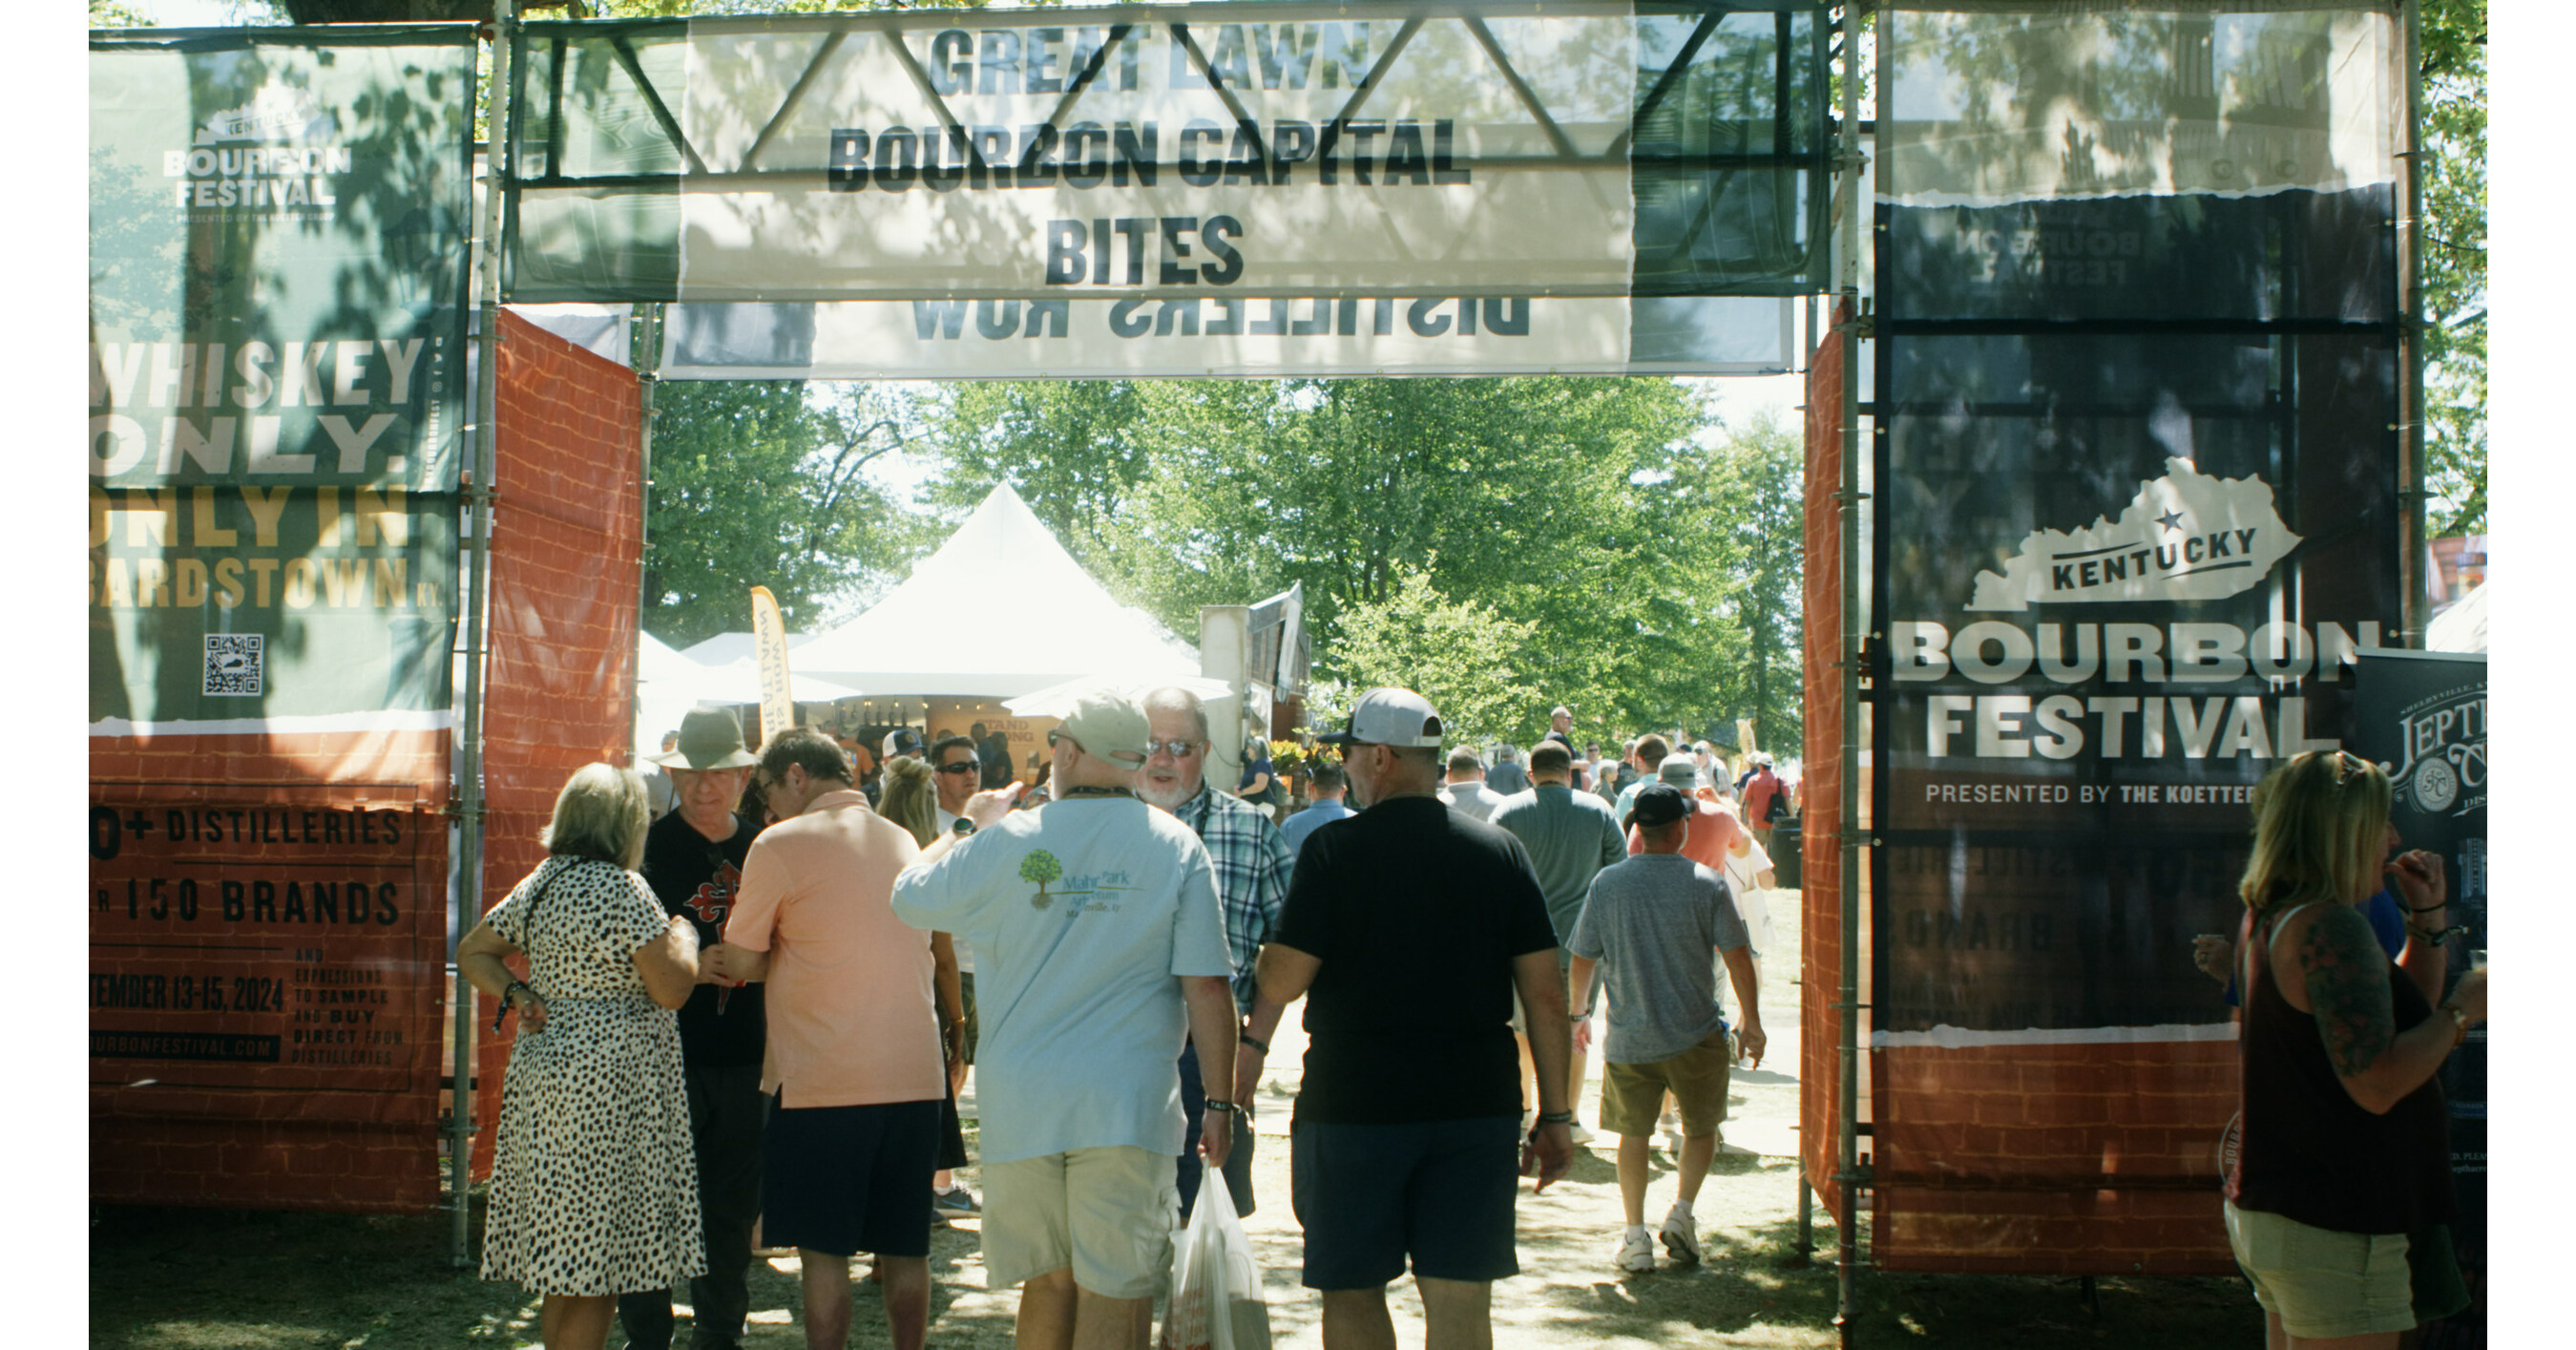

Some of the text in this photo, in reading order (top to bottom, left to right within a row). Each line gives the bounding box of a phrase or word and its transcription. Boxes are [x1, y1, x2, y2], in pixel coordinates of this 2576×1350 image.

[929, 21, 1370, 96] GREAT LAWN
[162, 146, 352, 178] BOURBON
[827, 117, 1472, 194] BOURBON CAPITAL
[176, 179, 337, 208] FESTIVAL
[1045, 215, 1245, 286] BITES
[89, 337, 426, 410] WHISKEY
[89, 412, 406, 477] ONLY.
[317, 484, 409, 548] IN
[2051, 527, 2257, 592] KENTUCKY
[89, 557, 444, 609] ARDSTOWN KY.
[1891, 620, 2380, 684] BOURBON
[1926, 694, 2342, 760] FESTIVAL
[1925, 785, 2070, 804] PRESENTED
[2080, 785, 2110, 804] BY
[2120, 785, 2160, 804] THE
[167, 810, 400, 845] DISTILLERIES
[128, 878, 198, 922] 150
[221, 879, 399, 926] BRANDS
[295, 948, 324, 963] AND
[295, 968, 382, 984] EXPRESSIONS
[172, 976, 227, 1013] 13-15,
[233, 978, 283, 1012] 2024
[295, 988, 388, 1004] TO SAMPLE
[293, 1029, 402, 1044] DIRECT FROM
[294, 1009, 375, 1023] AND BUY
[291, 1048, 392, 1066] DISTILLERIES
